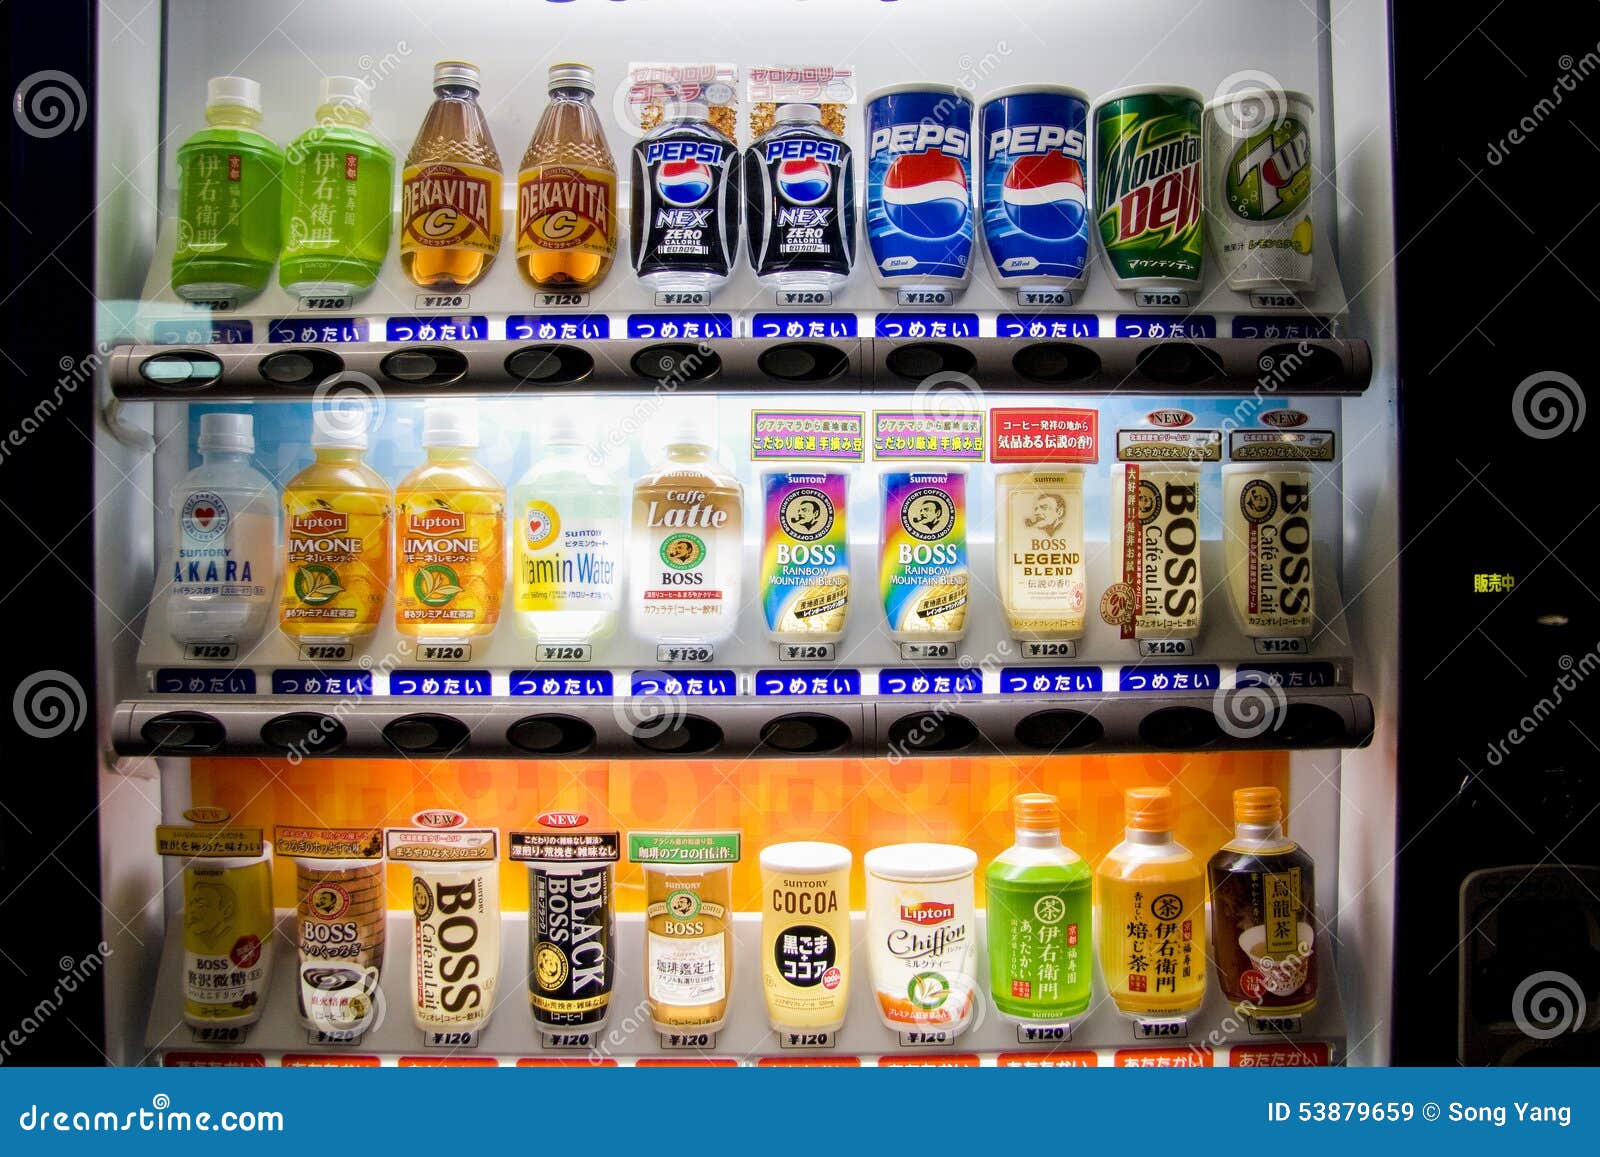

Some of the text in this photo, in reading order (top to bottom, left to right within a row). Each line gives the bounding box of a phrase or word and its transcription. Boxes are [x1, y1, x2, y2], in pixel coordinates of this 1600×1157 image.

[871, 124, 969, 159] PEPSI
[648, 142, 723, 166] PEPSI
[766, 140, 839, 165] PEPSI
[311, 152, 338, 249] 伊右衛門
[404, 179, 489, 231] DEKAVITA
[521, 182, 607, 233] DEKAVITA
[423, 208, 457, 236] C
[543, 210, 577, 239] C
[656, 208, 713, 228] NEX
[777, 208, 833, 227] NEX
[665, 230, 702, 239] ZERO
[786, 229, 824, 238] ZERO
[307, 298, 345, 309] ¥120
[423, 296, 463, 306] ¥120
[542, 295, 582, 305] ¥120
[664, 294, 703, 304] ¥120
[785, 294, 824, 303] ¥120
[906, 293, 945, 303] ¥120
[1026, 294, 1064, 304] ¥120
[1142, 295, 1181, 305] ¥120
[279, 326, 360, 342] つめたい
[396, 325, 479, 341] つめたい
[515, 324, 600, 340] つめたい
[637, 322, 722, 338] つめたい
[762, 322, 847, 337] つめたい
[885, 321, 969, 337] つめたい
[1006, 322, 1089, 337] つめたい
[1125, 323, 1206, 338] つめたい
[1154, 412, 1185, 424] NEW
[1268, 412, 1300, 424] NEW
[909, 476, 948, 484] SUNTORY
[296, 516, 342, 529] Lipton
[414, 516, 460, 528] Lipton
[647, 501, 727, 528] Latte
[1032, 539, 1066, 551] BOSS
[1164, 482, 1197, 618] BOSS
[1280, 482, 1309, 616] BOSS
[776, 544, 836, 565] BOSS
[898, 544, 957, 565] BOSS
[1014, 553, 1080, 565] LEGEND
[174, 561, 251, 582] AKARA
[576, 552, 614, 584] Water
[782, 565, 829, 576] RAINBOW
[905, 565, 951, 575] RAINBOW
[1024, 567, 1073, 576] BLEND
[1145, 525, 1163, 616] Café au Lait
[1260, 524, 1279, 614] Café au Lait
[662, 572, 703, 585] BOSS
[1474, 573, 1515, 592] 販売中
[192, 647, 230, 657] ¥120
[307, 647, 345, 658] ¥120
[425, 647, 464, 658] ¥120
[545, 647, 584, 658] ¥120
[787, 647, 827, 658] ¥120
[1030, 644, 1069, 655] ¥120
[1148, 642, 1185, 653] ¥120
[1263, 640, 1299, 651] ¥120
[165, 677, 246, 693] つめたい
[281, 677, 364, 693] つめたい
[399, 678, 482, 695] つめたい
[518, 678, 603, 695] つめたい
[641, 680, 726, 695] つめたい
[765, 677, 851, 695] つめたい
[1010, 675, 1093, 692] つめたい
[1129, 674, 1210, 690] つめたい
[423, 814, 455, 826] NEW
[548, 814, 579, 825] NEW
[783, 880, 828, 888] SUNTORY
[773, 890, 838, 914] COCOA
[1272, 877, 1290, 939] 烏龍茶
[549, 878, 568, 943] BOSS
[903, 908, 951, 922] Lipton
[304, 922, 357, 943] BOSS
[571, 871, 605, 993] BLACK
[665, 921, 704, 935] BOSS
[436, 879, 480, 1012] BOSS
[783, 934, 828, 955] 黒ごま
[888, 924, 968, 960] Chiffon
[1020, 920, 1032, 978] あったかい
[1127, 921, 1149, 973] 焙じ茶
[196, 958, 228, 970] BOSS
[1037, 926, 1060, 1000] 伊右衛門
[1154, 922, 1178, 993] 伊右衛門
[423, 923, 440, 1010] Café au Lait
[784, 962, 827, 979] ココア
[1026, 1028, 1064, 1040] ¥120
[1142, 1023, 1179, 1035] ¥120
[432, 1033, 472, 1044] ¥120
[550, 1034, 589, 1045] ¥120
[669, 1034, 708, 1046] ¥120
[788, 1033, 827, 1045] ¥120
